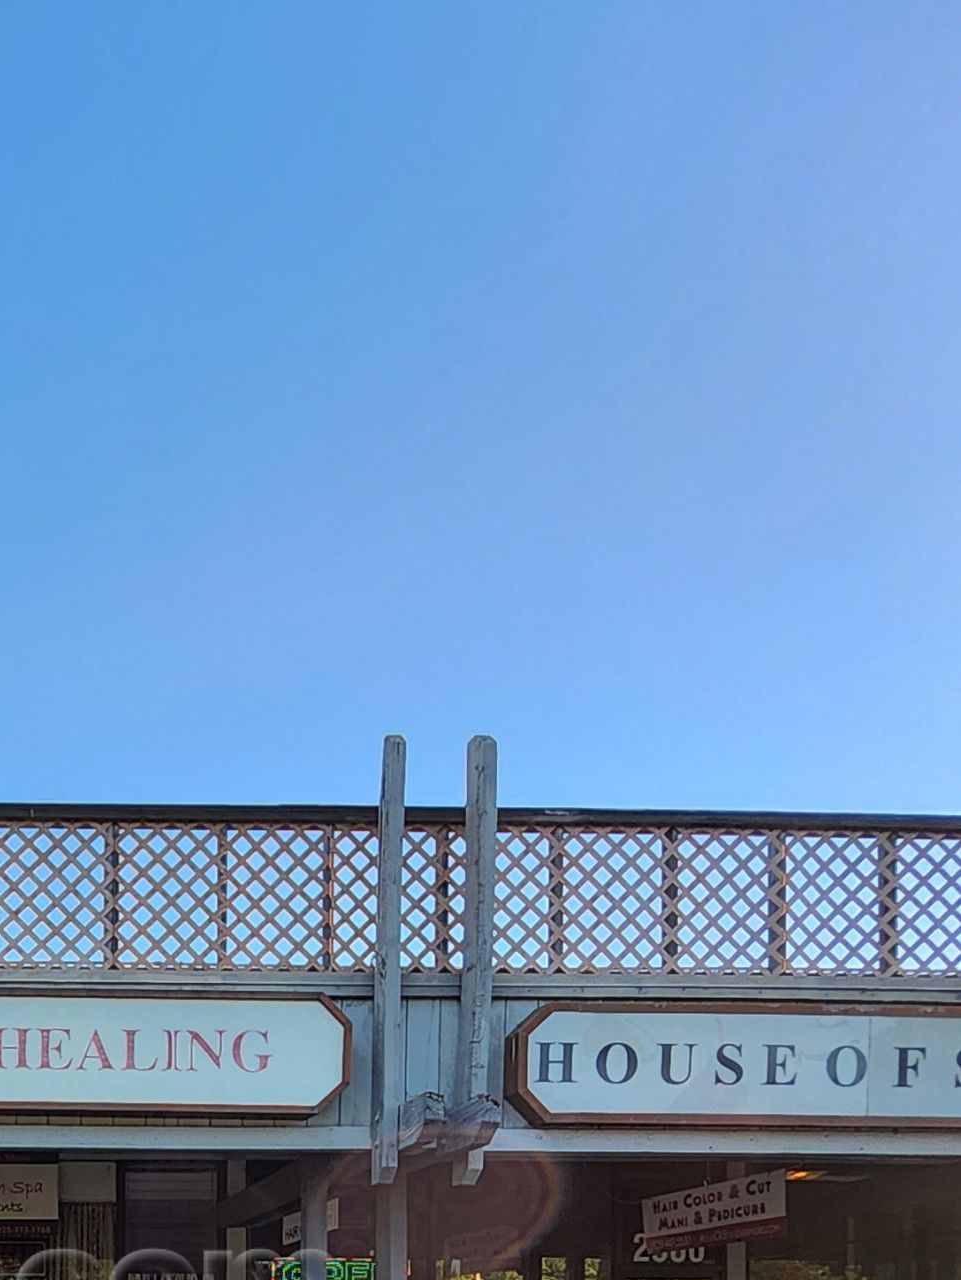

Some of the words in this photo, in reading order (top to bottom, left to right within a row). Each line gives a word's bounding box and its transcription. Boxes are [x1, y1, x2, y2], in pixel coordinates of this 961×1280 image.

[533, 1041, 798, 1087] HOUSE
[826, 1044, 927, 1089] OF
[10, 1180, 44, 1199] Spa
[729, 1184, 741, 1199] &
[694, 1211, 703, 1225] &
